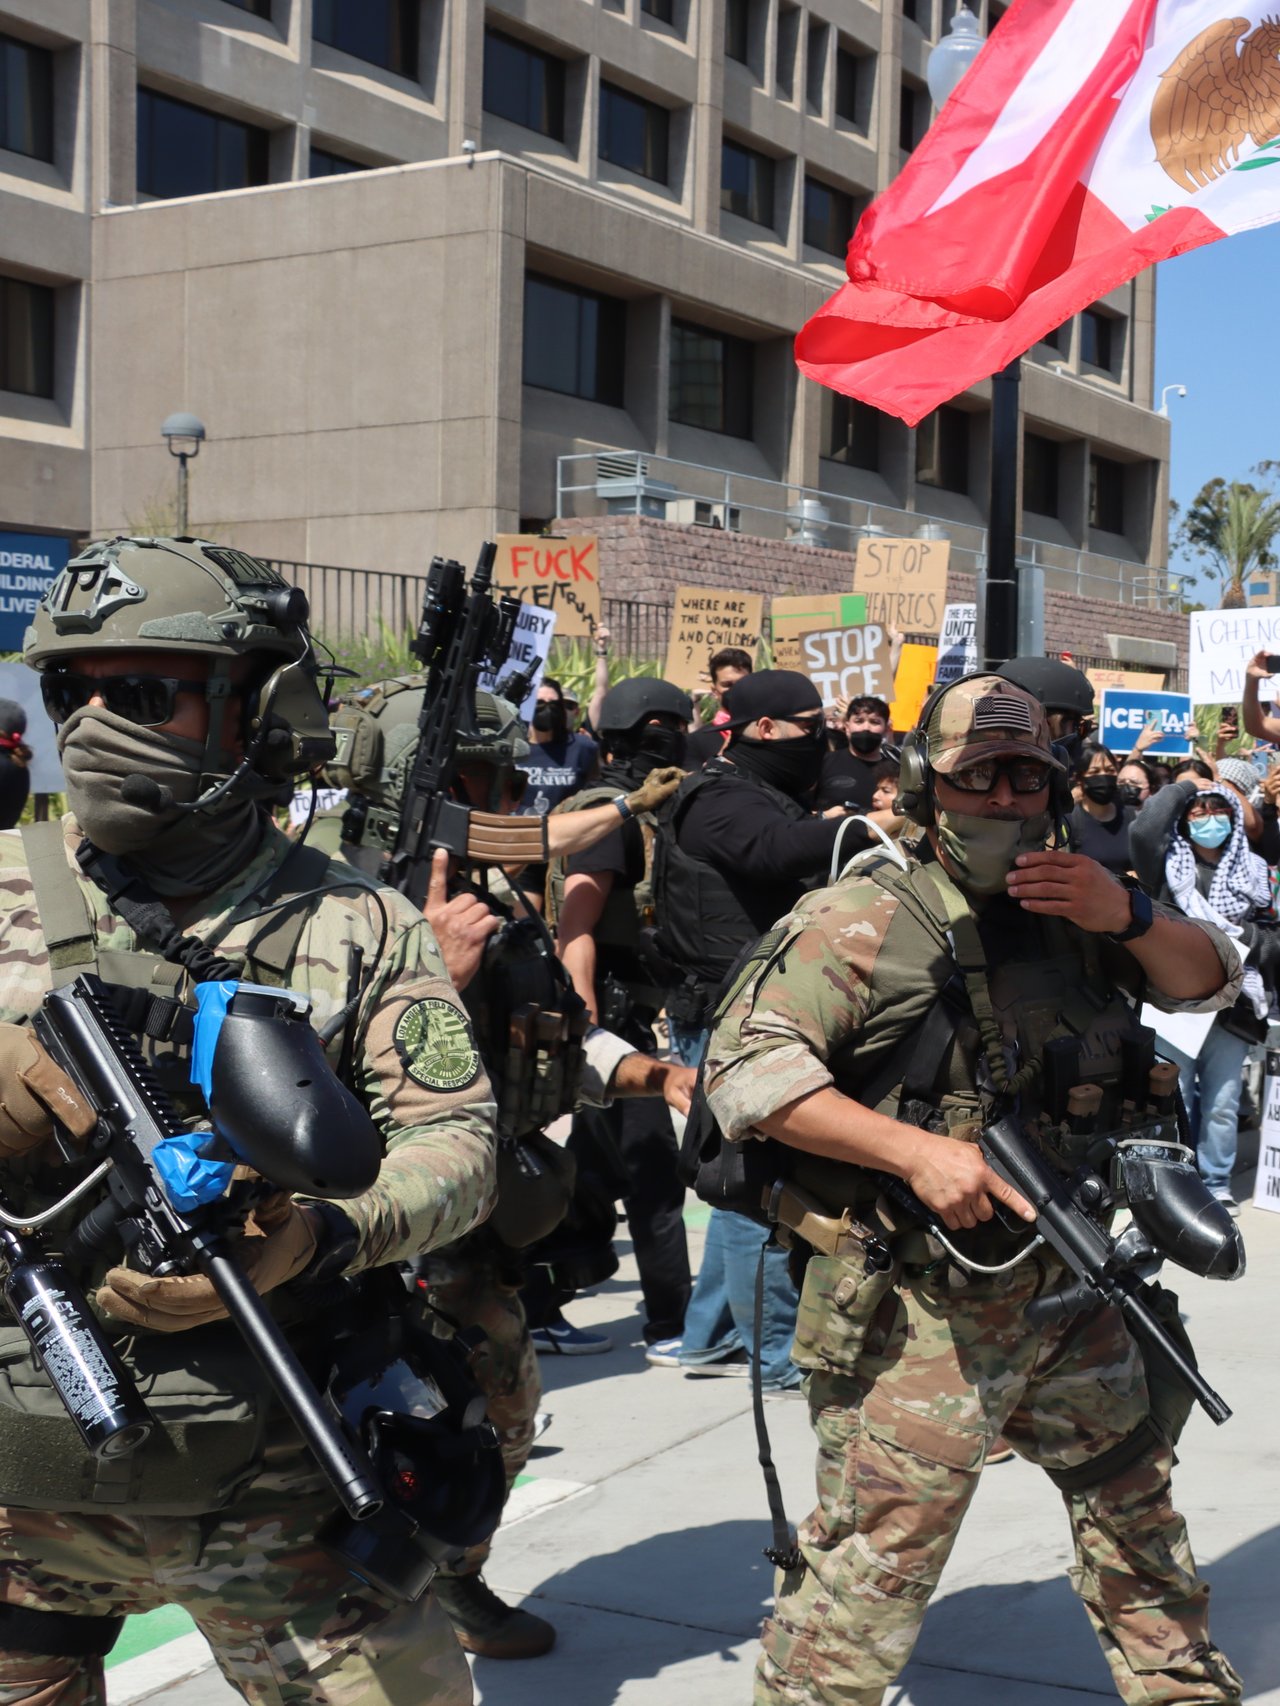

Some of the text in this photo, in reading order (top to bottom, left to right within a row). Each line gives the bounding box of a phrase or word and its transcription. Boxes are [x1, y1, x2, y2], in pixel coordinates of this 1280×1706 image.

[510, 542, 595, 581] FUCK
[864, 543, 931, 577] STOP
[0, 597, 41, 613] LIVE
[681, 599, 746, 613] WHERE ARE
[866, 592, 937, 629] HEATRICS
[681, 614, 749, 628] THE WOMEN
[962, 609, 977, 620] PEO
[945, 621, 977, 637] UNIT
[678, 631, 760, 647] AND CHILDREN
[804, 625, 883, 669] STOP
[811, 664, 886, 708] ICE
[1095, 673, 1125, 683] ICE
[1104, 707, 1145, 729] ICE
[411, 1066, 441, 1087] SPECIAL
